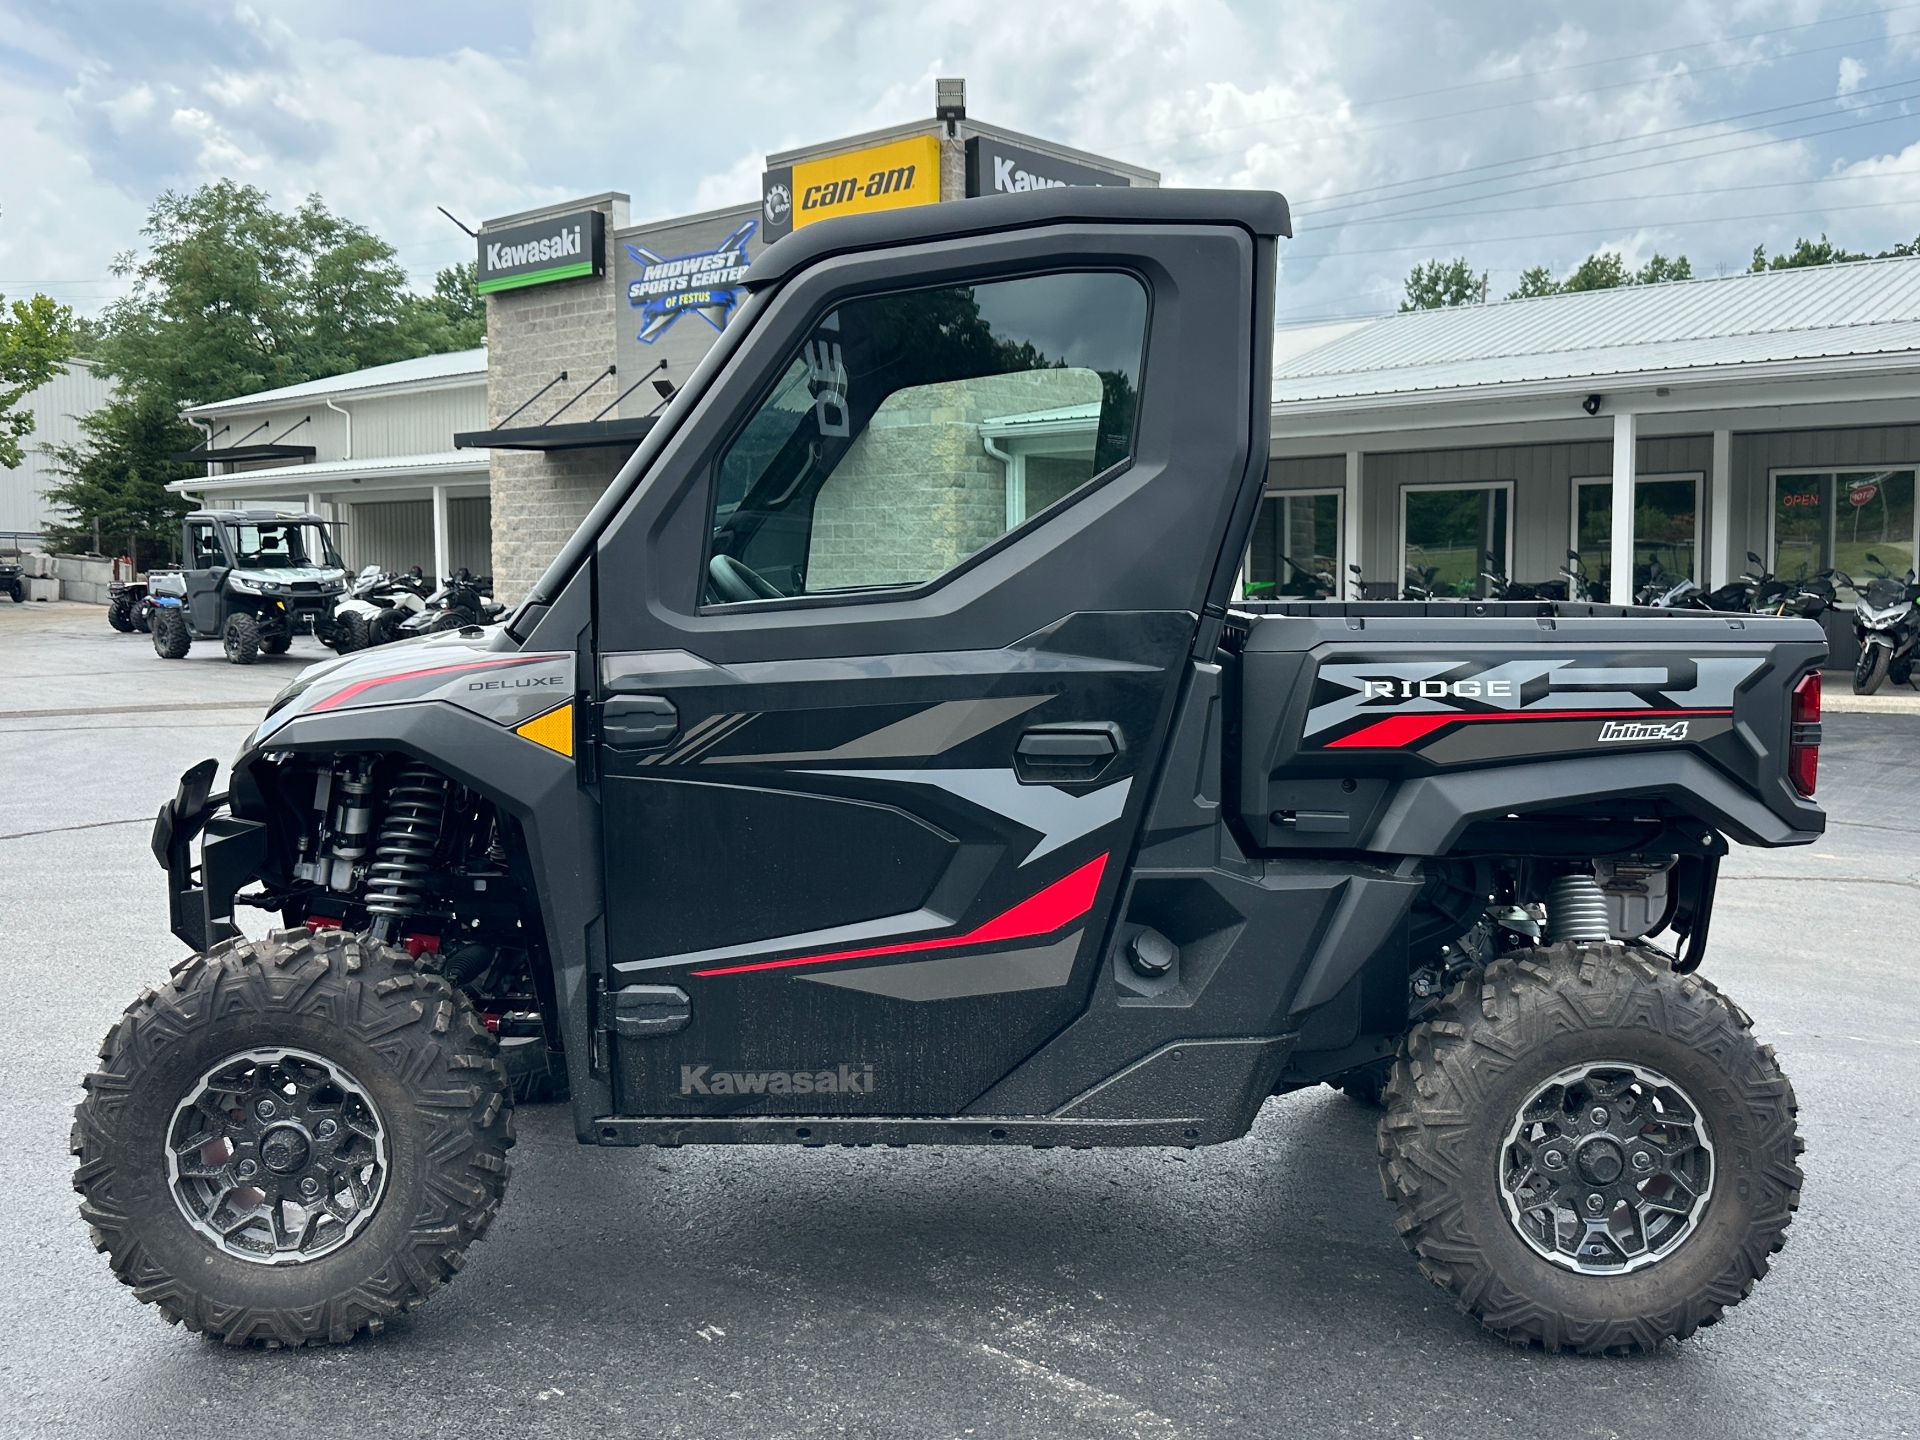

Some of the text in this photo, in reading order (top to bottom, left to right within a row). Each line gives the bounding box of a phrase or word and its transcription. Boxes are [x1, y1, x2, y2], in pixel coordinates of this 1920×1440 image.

[487, 225, 580, 271] Kawasaki
[643, 250, 740, 281] MIDWEST
[629, 276, 688, 298] SPORTS
[665, 291, 711, 309] OF FESTUS
[1783, 494, 1819, 506] OPEN
[469, 676, 564, 691] DELUXE
[1364, 680, 1512, 698] RIDGE
[680, 1064, 874, 1095] Kawasaki
